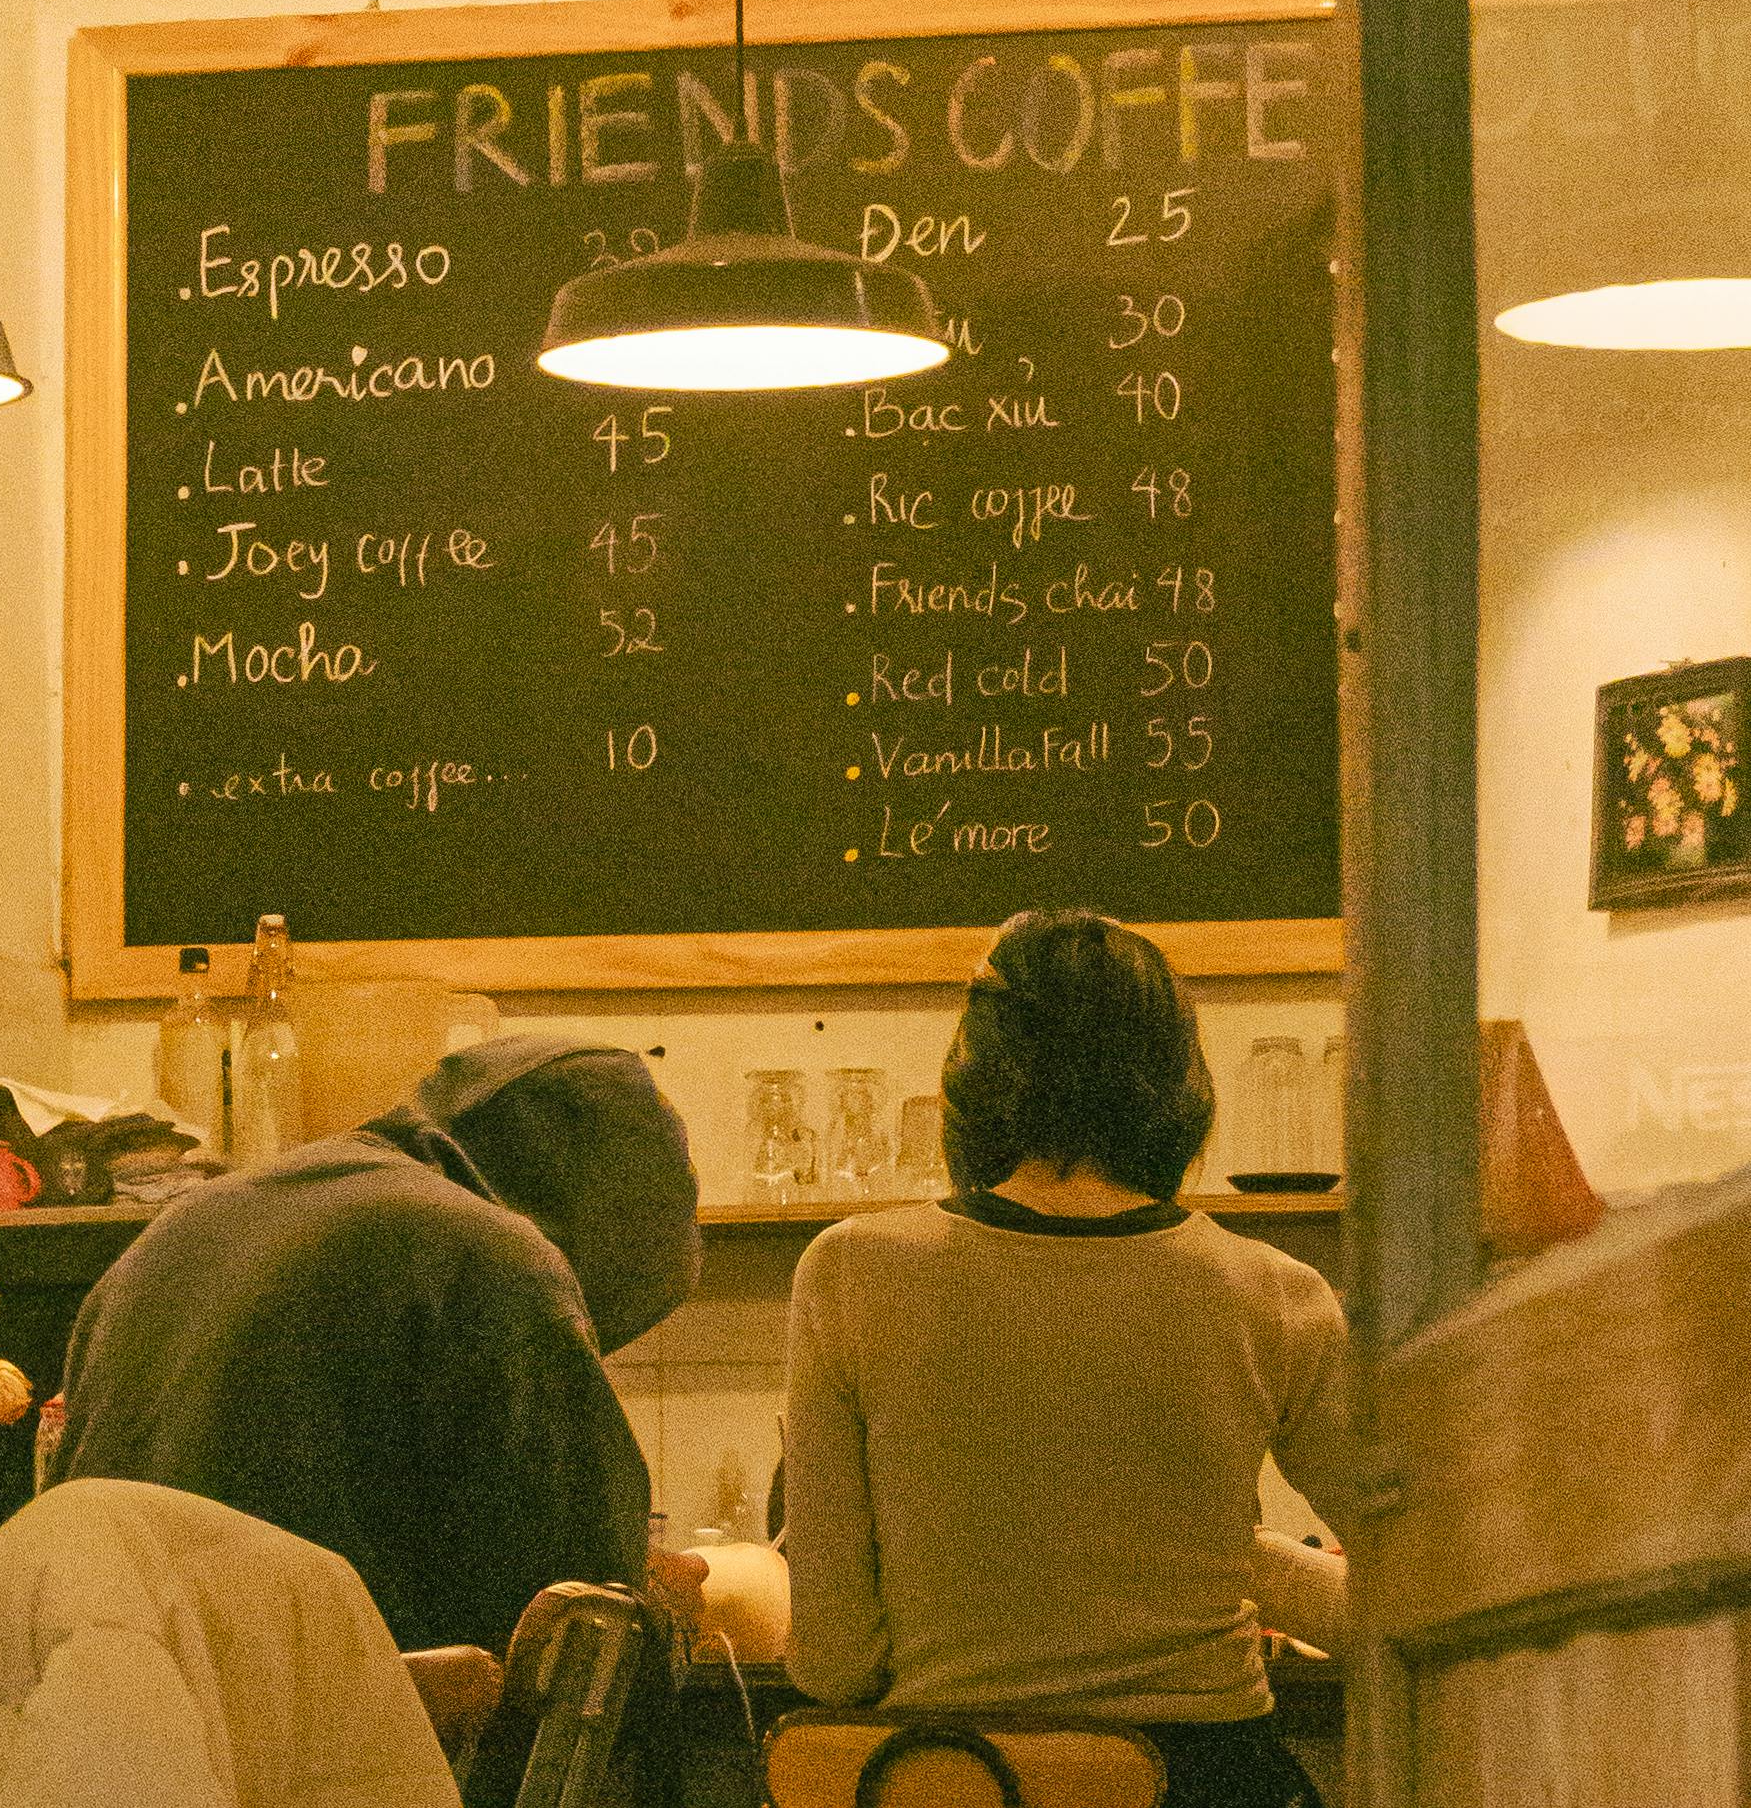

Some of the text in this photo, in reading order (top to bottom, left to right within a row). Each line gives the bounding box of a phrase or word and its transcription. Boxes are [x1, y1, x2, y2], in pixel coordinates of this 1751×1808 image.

[366, 60, 911, 194] FRIENDS
[1107, 188, 1196, 248] 25
[199, 224, 450, 319] Espresso
[1108, 294, 1186, 350] 30
[193, 346, 495, 409] Americano
[1116, 370, 1182, 425] 40
[592, 405, 672, 473] 45
[1131, 465, 1193, 519] 48
[205, 522, 331, 601] Joey
[589, 513, 664, 575] 45
[871, 561, 1216, 626] Friends chai 48
[192, 607, 664, 684] Mocha 52
[871, 640, 1215, 707] Red cold 50
[209, 752, 337, 800] extra
[607, 725, 659, 772] 10
[1146, 715, 1214, 772] 55
[1139, 798, 1222, 850] 50
